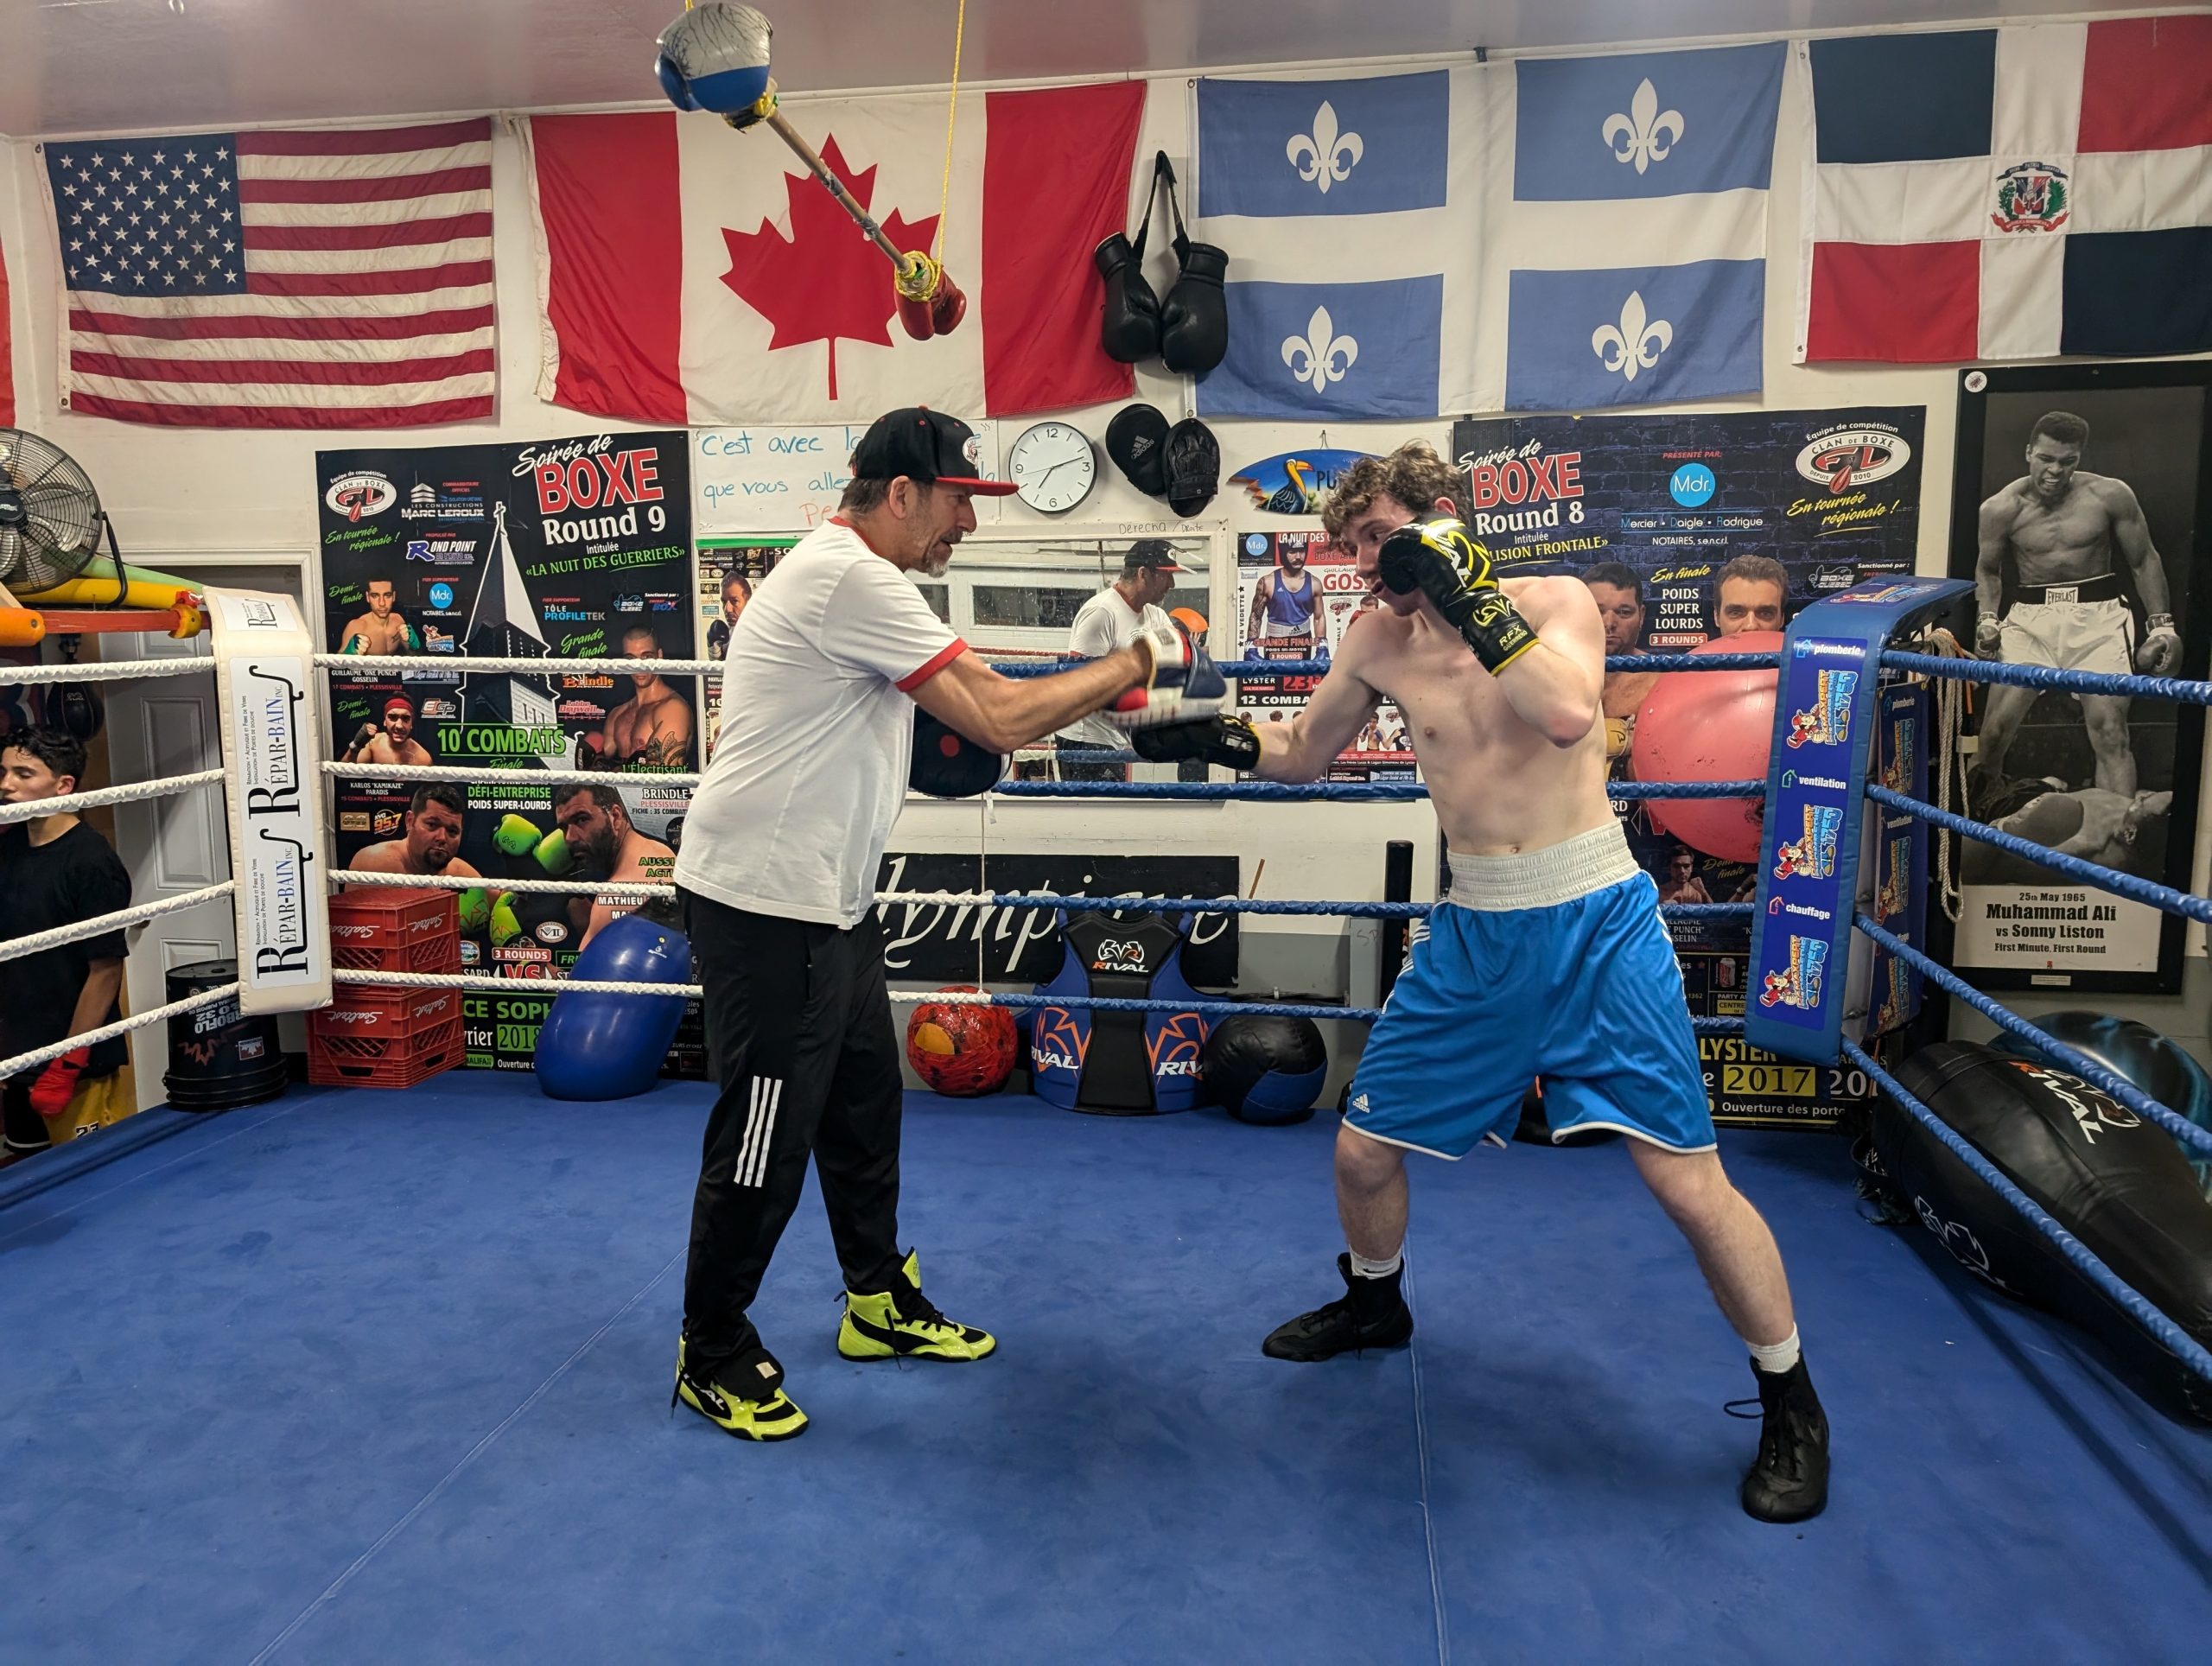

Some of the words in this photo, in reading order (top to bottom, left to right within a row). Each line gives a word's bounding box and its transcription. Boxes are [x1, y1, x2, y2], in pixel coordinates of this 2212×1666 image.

[1046, 429, 1058, 437] 12
[1807, 426, 1834, 442] Équipe
[1849, 422, 1898, 433] compétition
[702, 430, 753, 455] C'est
[768, 436, 823, 453] avec
[1131, 438, 1154, 460] adidas
[1812, 437, 1842, 455] CLAN
[1863, 436, 1895, 448] BOXE
[512, 440, 585, 477] Soirée
[588, 434, 613, 455] de
[1459, 446, 1517, 474] Soirée
[1519, 438, 1542, 459] de
[1015, 464, 1024, 474] 9
[1082, 462, 1090, 472] 3
[330, 472, 346, 484] Équipe
[355, 470, 386, 479] compétition
[534, 448, 664, 514] BOXE
[1471, 452, 1585, 509] BOXE
[1809, 470, 1829, 480] DEPUIS
[334, 481, 353, 493] CLAN
[365, 480, 385, 489] BOXE
[704, 484, 734, 508] que
[742, 480, 788, 495] vous
[1049, 498, 1058, 507] 6
[1787, 499, 1814, 517] En
[1814, 492, 1867, 512] tournée
[402, 508, 435, 520] MARC
[1475, 503, 1559, 536] Round
[1568, 501, 1585, 524] 8
[1821, 503, 1886, 528] régionale
[543, 506, 638, 545] Round
[648, 506, 665, 531] 9
[1119, 523, 1166, 535] Derecha
[1621, 518, 1657, 528] Mercier
[1670, 518, 1703, 530] Daigle
[1717, 517, 1763, 528] Rodrigue
[325, 531, 342, 544] En
[343, 525, 378, 539] tournée
[1279, 533, 1288, 544] LA
[1290, 533, 1307, 543] NUIT
[1310, 533, 1325, 542] DES
[1515, 532, 1549, 544] Intitulée
[1652, 537, 1695, 545] NOTAIRES,
[451, 541, 477, 551] POINT
[587, 542, 619, 555] Intitulée
[550, 559, 580, 574] NUIT
[583, 556, 607, 569] DES
[1650, 568, 1672, 583] En
[1674, 564, 1712, 580] finale
[341, 594, 363, 604] finale
[1662, 588, 1700, 599] POIDS
[2047, 588, 2076, 604] EVERLAST
[1660, 603, 1700, 614] SUPER
[1655, 618, 1703, 629] LOURDS
[1239, 629, 1244, 639] EN
[1499, 625, 1522, 646] RFX
[1503, 630, 1528, 651] GUERRERO
[1662, 635, 1704, 644] ROUNDS
[561, 628, 604, 654] Grande
[1253, 638, 1289, 647] GRANDE
[1290, 638, 1320, 646] FINALE
[578, 643, 607, 658] finale
[1814, 645, 1861, 655] plomberie
[1284, 677, 1308, 690] 23
[1834, 672, 1858, 710] 1750
[1241, 696, 1256, 704] 12
[1892, 697, 1915, 710] plomberie
[350, 707, 371, 719] finale
[437, 728, 461, 753] 10
[467, 728, 566, 754] COMBATS
[248, 697, 301, 819] RÉPAR-BAIN
[1799, 776, 1847, 790] ventilation
[467, 784, 551, 798] DÉFI-ENTREPRISE
[643, 789, 688, 799] BRINDLE
[467, 800, 492, 810] POIDS
[493, 800, 551, 811] SUPER-LOURDS
[375, 813, 402, 830] 95.7
[1821, 807, 1843, 844] 1750
[639, 857, 675, 866] AUSSI
[598, 896, 643, 906] MATHIEU
[2019, 893, 2037, 901] 25th
[2040, 893, 2059, 902] May
[1786, 903, 1830, 919] chauffage
[1986, 904, 2088, 920] Muhammad
[2093, 906, 2116, 921] Ali
[257, 860, 308, 979] RÉPAR-BAIN
[1996, 927, 2008, 937] vs
[2012, 925, 2056, 938] Sonny
[2060, 925, 2104, 938] Liston
[505, 951, 548, 959] ROUNDS
[1995, 943, 2016, 952] First
[2018, 944, 2051, 953] Minute,
[2053, 944, 2074, 953] First
[2076, 944, 2107, 954] Round
[1806, 940, 1828, 977] 1750
[505, 964, 541, 979] VS
[1092, 961, 1149, 973] RIVAL
[323, 1011, 383, 1024] Sealtest
[498, 1059, 531, 1068] Ouverture
[1032, 1046, 1079, 1069] RIVAL
[1727, 1066, 1811, 1093] 2017
[1722, 1102, 1783, 1114] Ouverture
[1788, 1103, 1808, 1115] des
[2008, 1060, 2103, 1144] RIVAL
